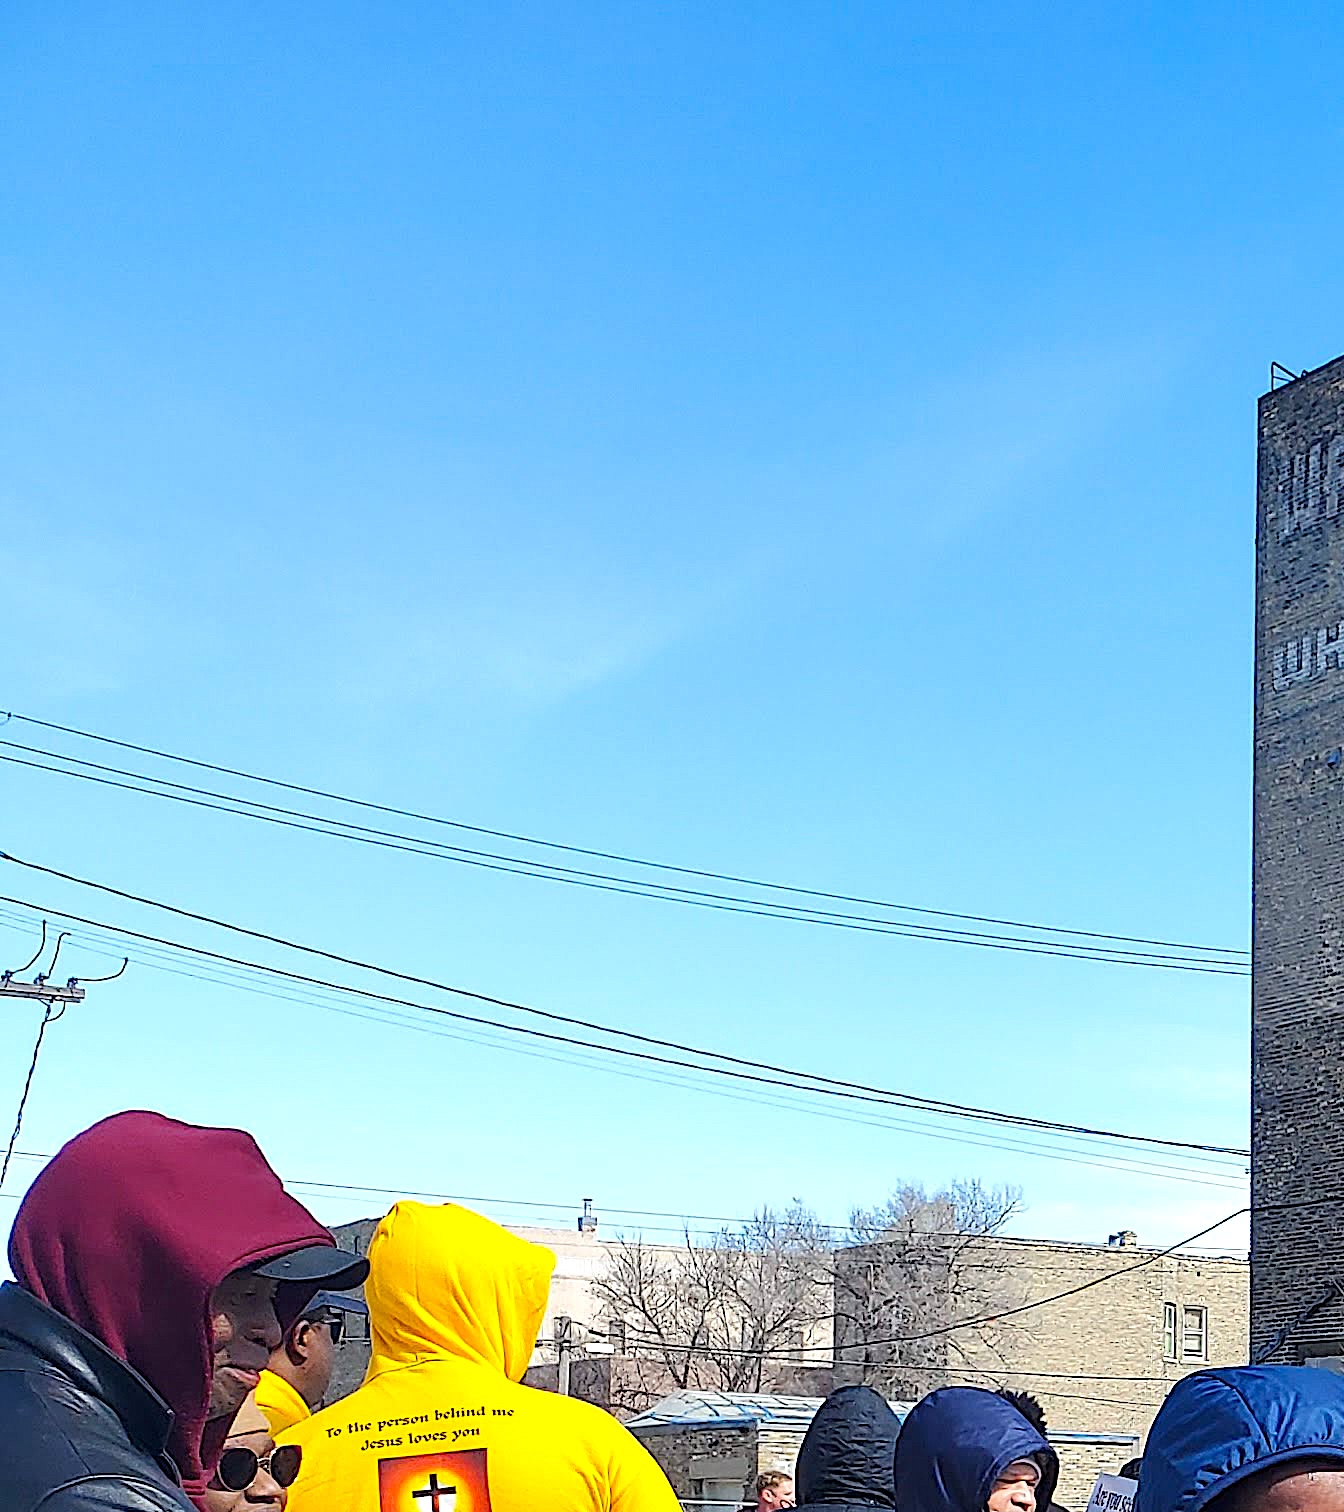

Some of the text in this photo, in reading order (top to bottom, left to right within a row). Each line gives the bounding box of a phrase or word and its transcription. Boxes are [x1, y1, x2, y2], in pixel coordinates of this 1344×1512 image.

[325, 1406, 515, 1438] To the person behind me
[360, 1428, 480, 1451] Jesus loves you
